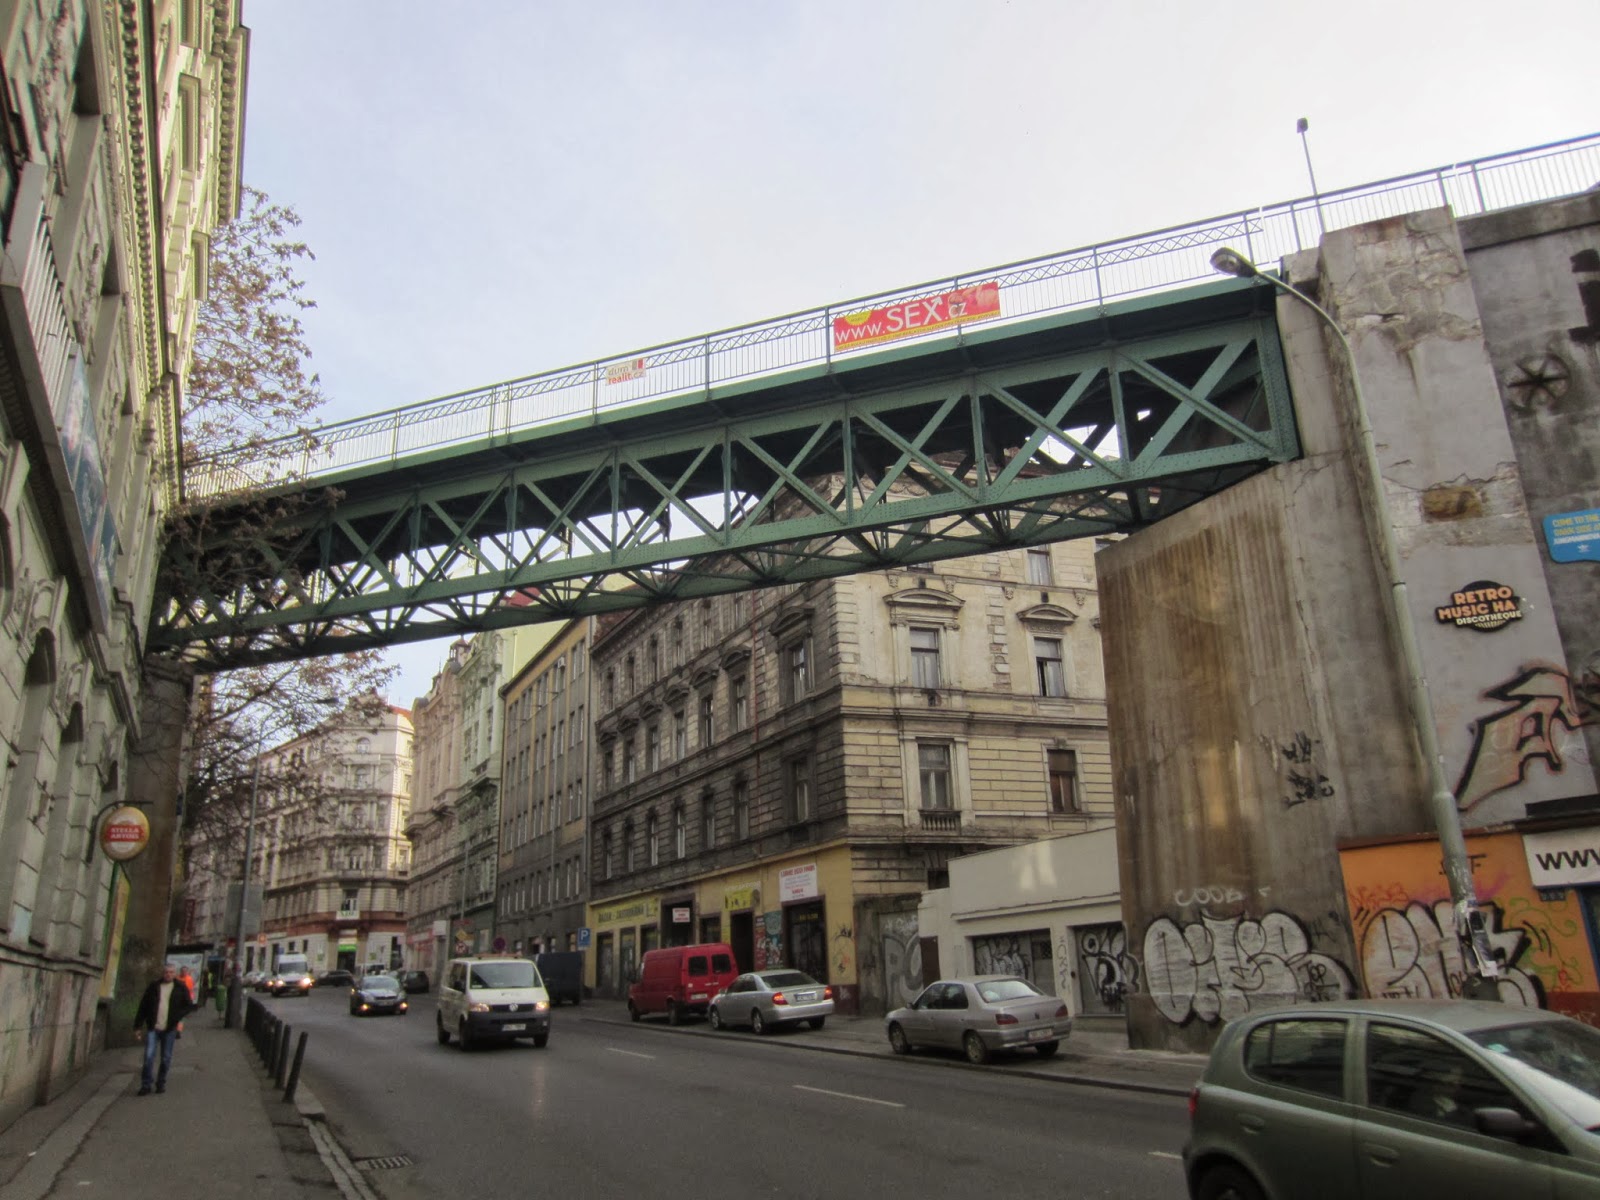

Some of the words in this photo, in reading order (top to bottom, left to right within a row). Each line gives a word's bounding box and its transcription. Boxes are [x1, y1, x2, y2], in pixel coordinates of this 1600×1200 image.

[1453, 586, 1513, 605] RETRO
[1438, 603, 1489, 620] MUSIC
[1456, 610, 1522, 625] DISCOTHEQUE
